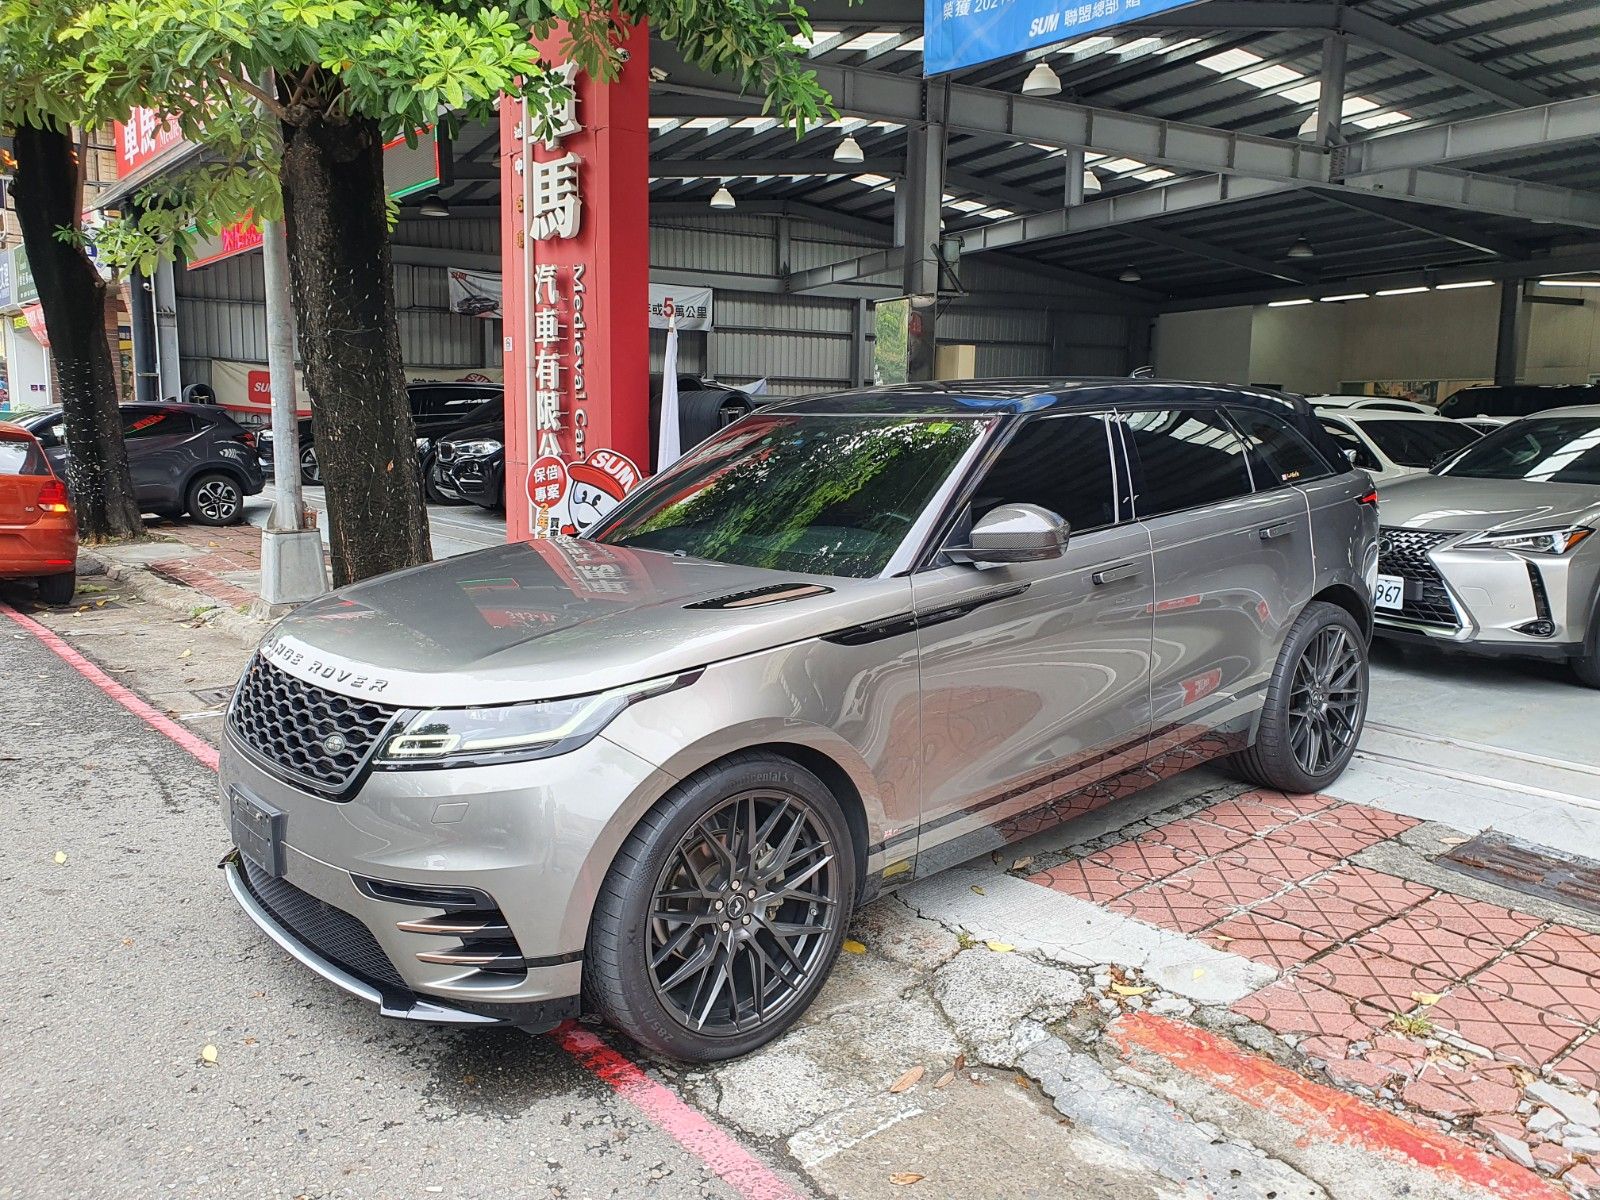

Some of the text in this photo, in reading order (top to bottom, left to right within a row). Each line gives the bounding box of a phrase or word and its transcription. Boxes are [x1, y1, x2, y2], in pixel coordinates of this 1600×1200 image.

[1029, 12, 1060, 38] SUM
[1064, 0, 1120, 27] 聯盟總部
[572, 263, 588, 460] Medieval Car
[534, 464, 559, 484] 保倍
[591, 452, 635, 495] SUM
[535, 484, 560, 502] 專案
[1376, 584, 1401, 603] 967
[308, 660, 389, 692] ROVER
